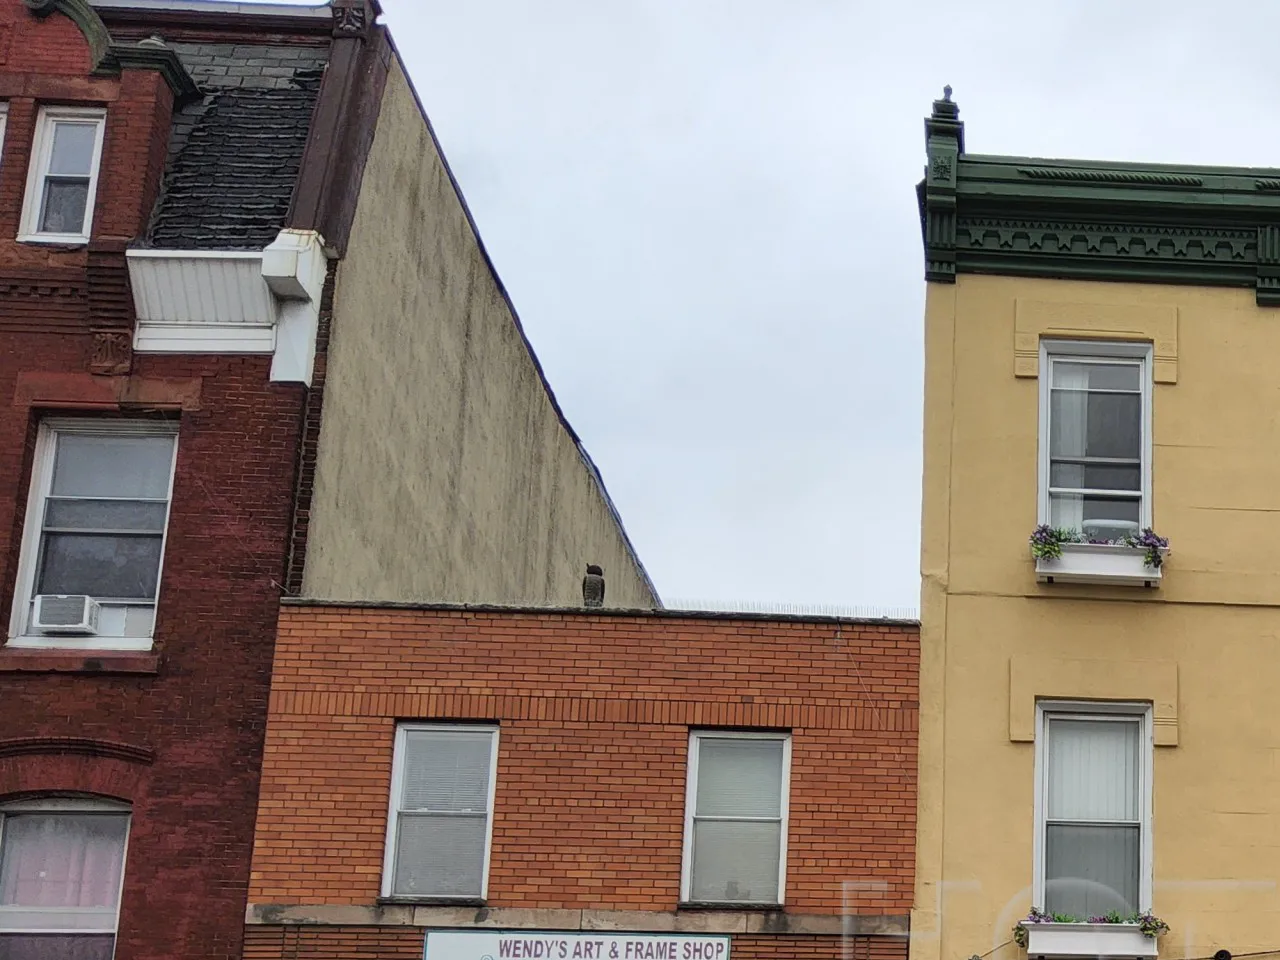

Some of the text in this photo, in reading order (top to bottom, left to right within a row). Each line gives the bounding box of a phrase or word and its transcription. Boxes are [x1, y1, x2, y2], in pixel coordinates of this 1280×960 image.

[499, 938, 725, 960] WENDY'S ART & FRAME SHOP
